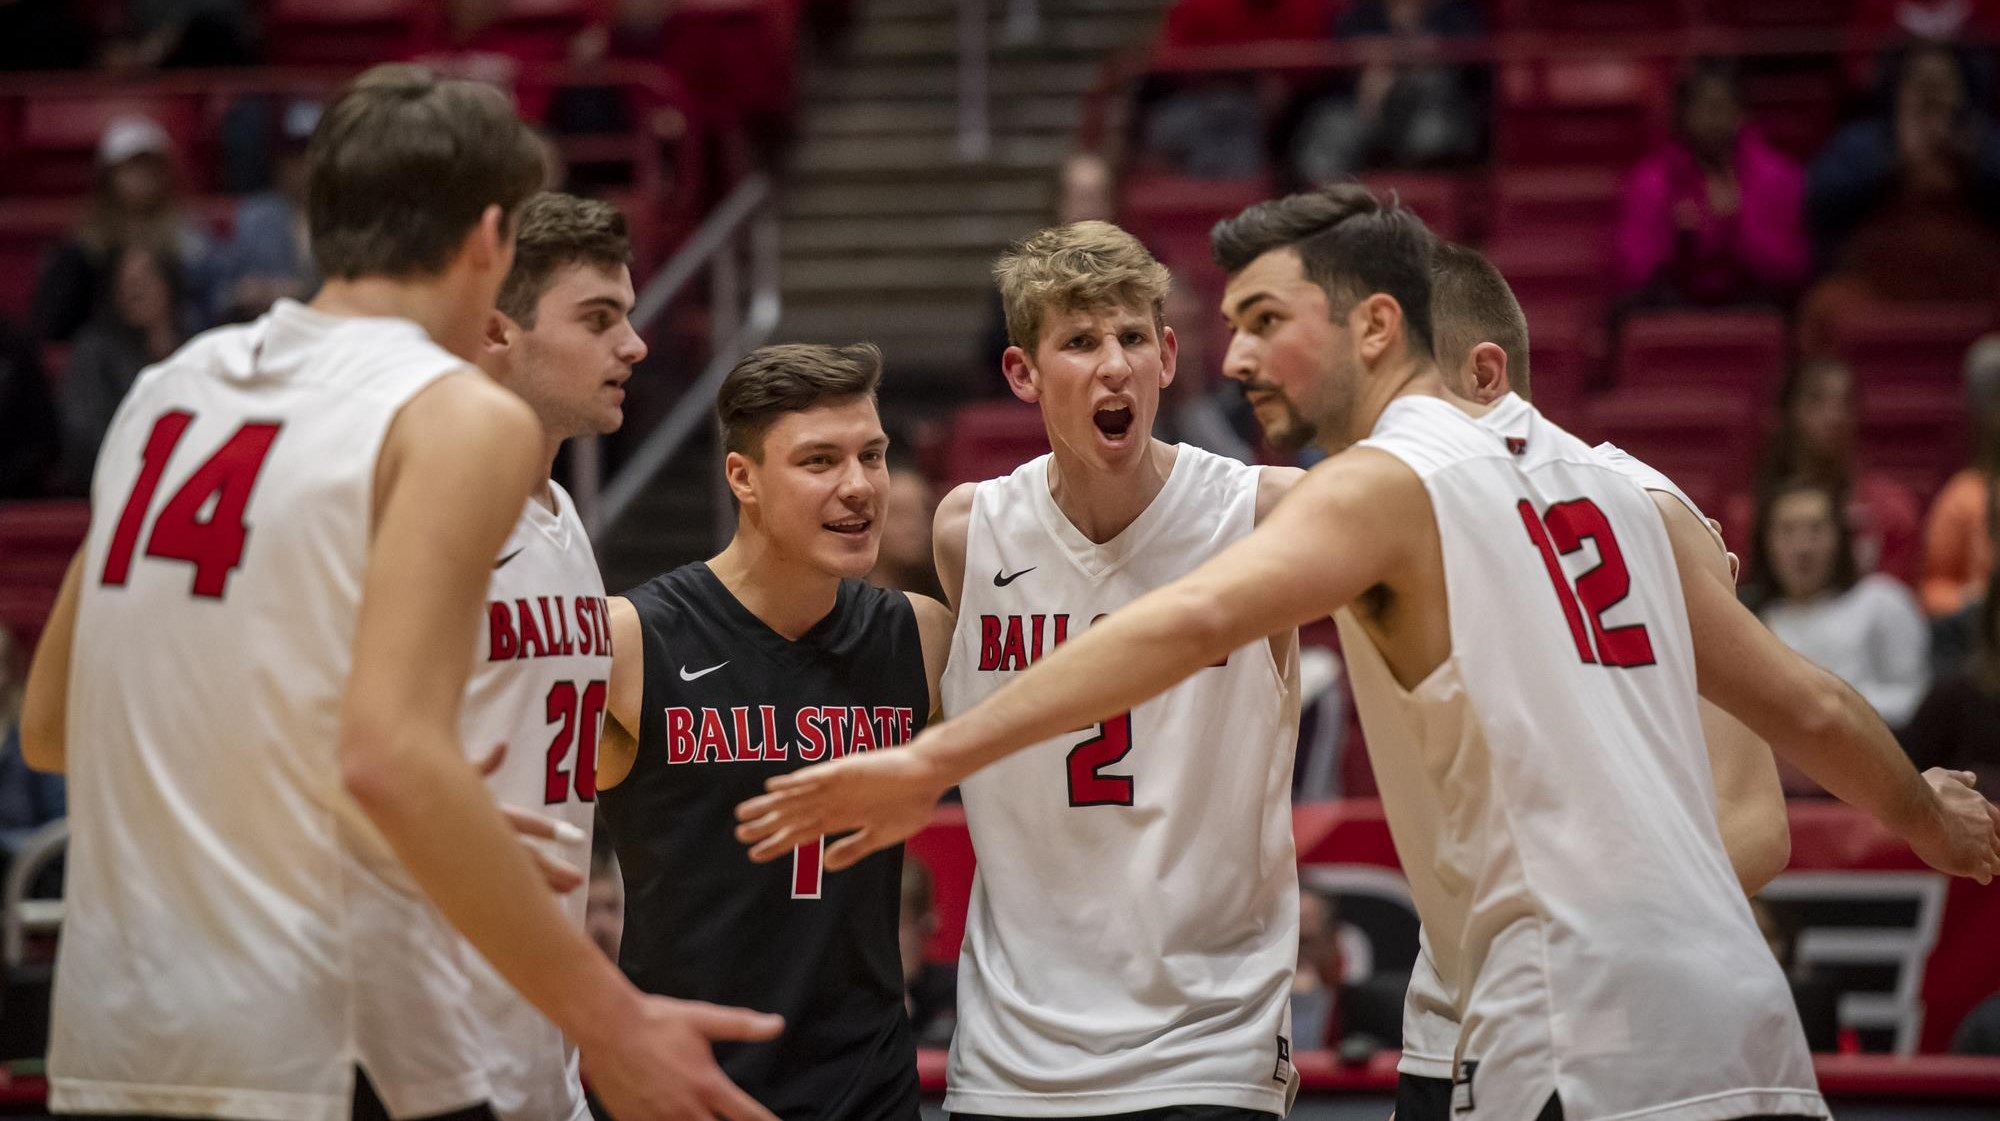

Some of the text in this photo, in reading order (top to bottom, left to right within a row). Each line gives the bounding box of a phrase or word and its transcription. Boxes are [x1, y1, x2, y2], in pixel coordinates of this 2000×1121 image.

[101, 408, 284, 603] 14
[488, 595, 613, 661] BALL STA
[1517, 497, 1657, 668] 12
[544, 680, 607, 805] 20
[665, 705, 913, 764] BALL STATE
[1066, 709, 1134, 808] 2
